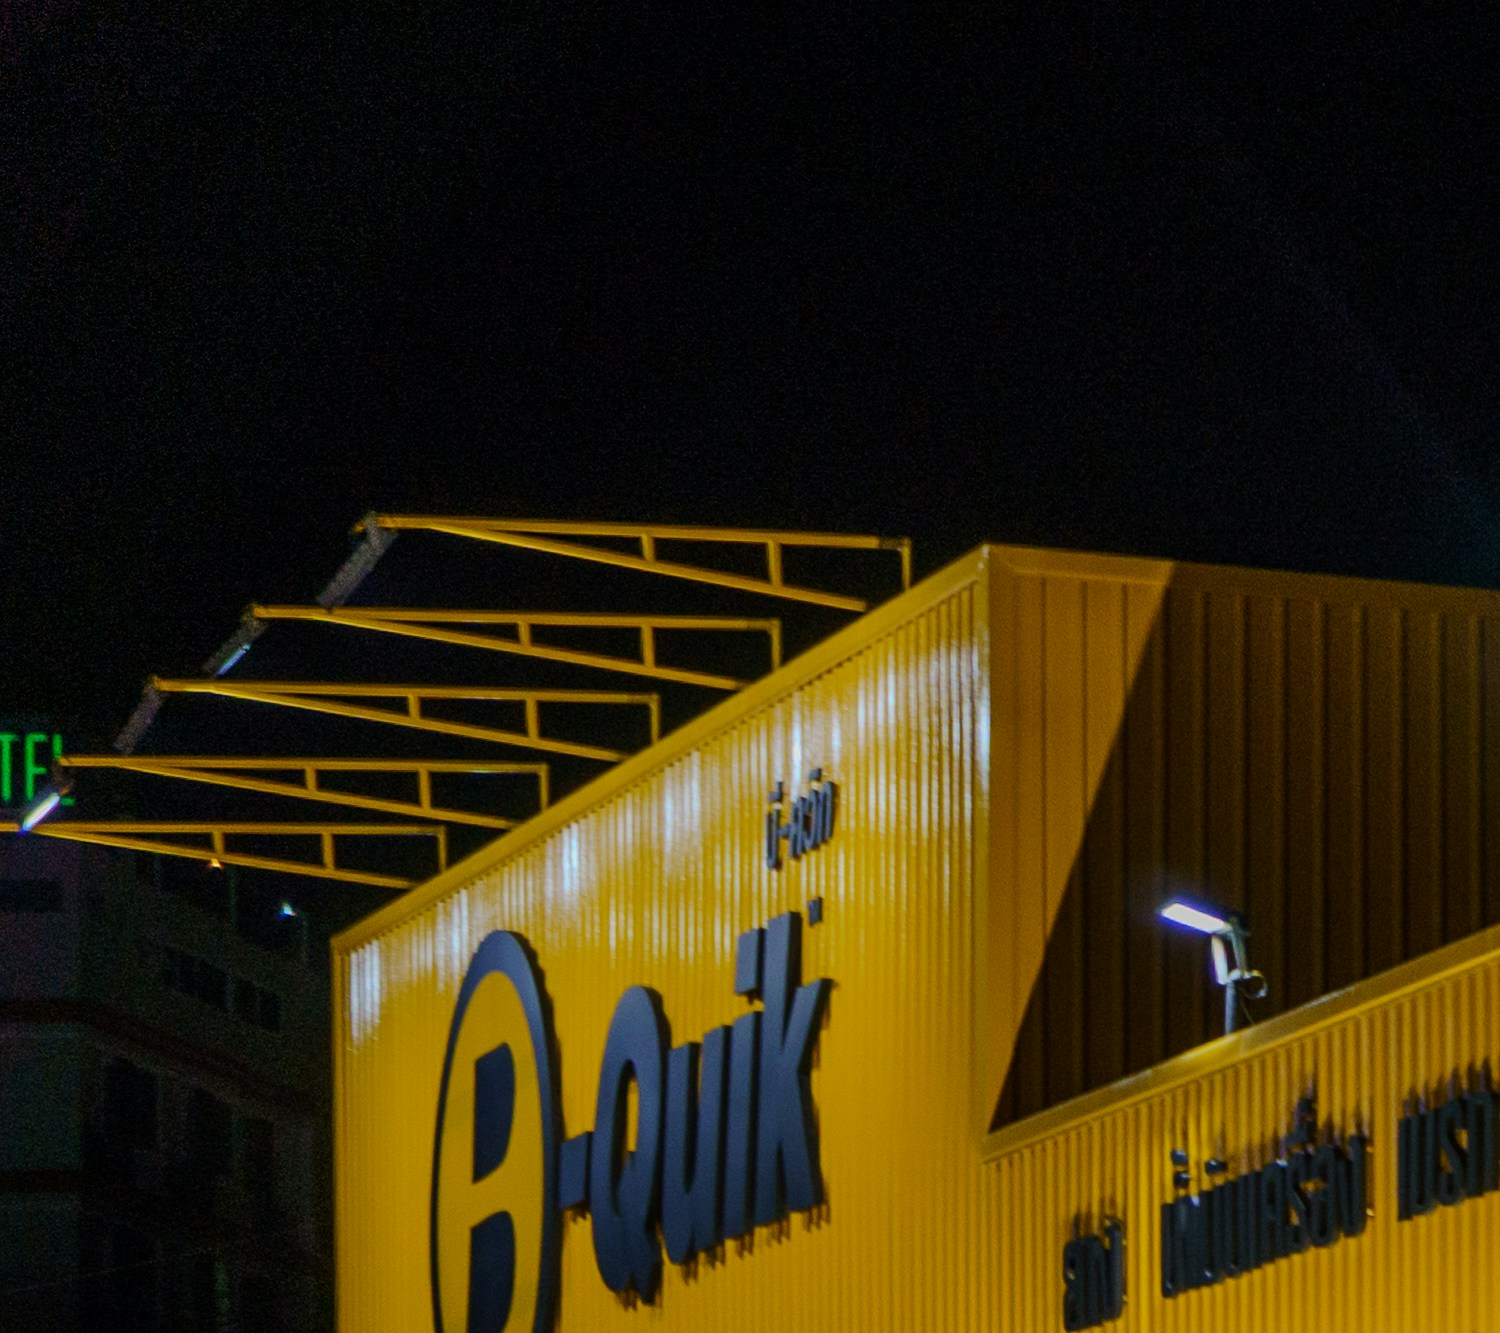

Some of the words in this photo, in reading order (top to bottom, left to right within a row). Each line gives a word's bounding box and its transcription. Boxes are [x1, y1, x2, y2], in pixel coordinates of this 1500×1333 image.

[1162, 1099, 1368, 1298] น้ำมันเครื่อง
[1399, 1089, 1500, 1222] เบรก
[1064, 1217, 1124, 1332] ยาง
